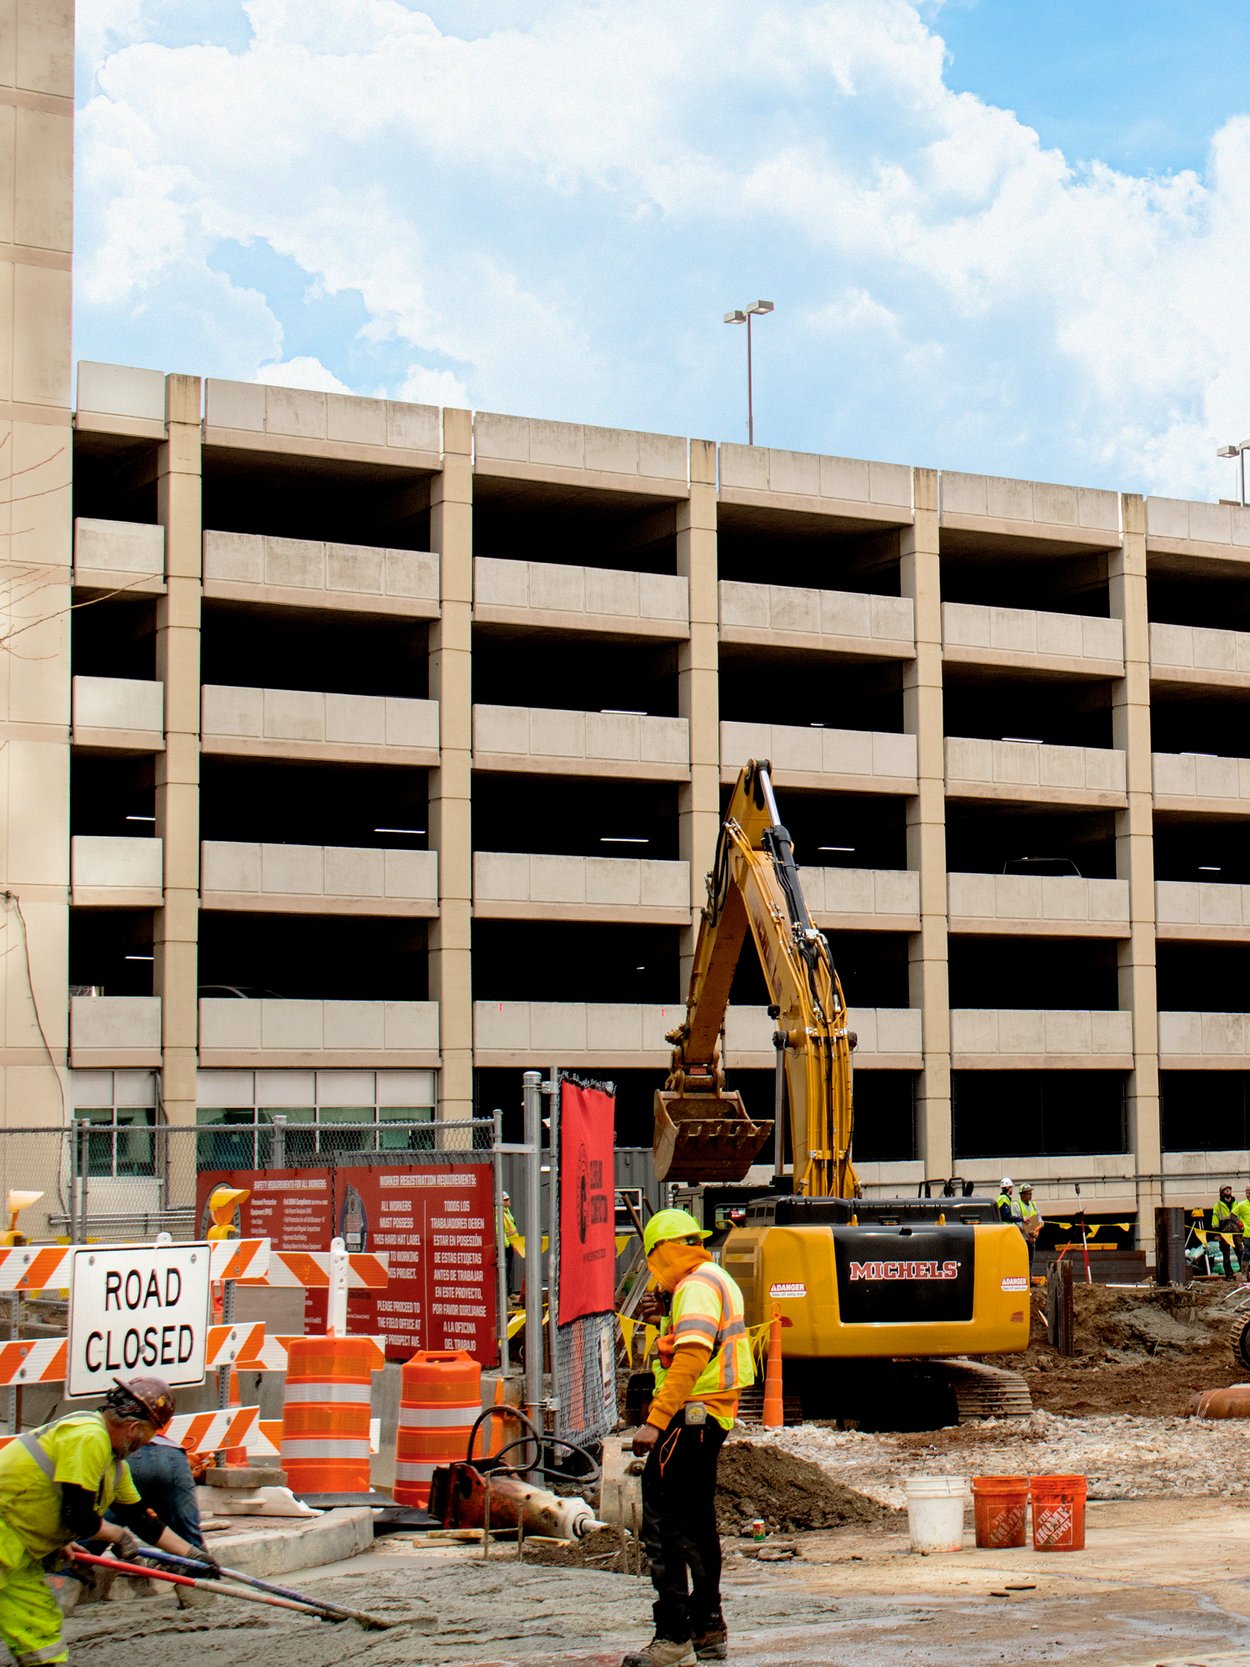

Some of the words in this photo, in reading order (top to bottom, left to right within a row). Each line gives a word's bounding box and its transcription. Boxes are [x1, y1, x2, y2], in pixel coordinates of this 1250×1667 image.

[400, 1175, 436, 1186] REGISTRATION
[381, 1201, 391, 1211] ALL
[391, 1201, 412, 1211] WORKERS
[444, 1201, 460, 1211] TODOS
[460, 1201, 470, 1211] LOS
[380, 1218, 392, 1228] MUST
[393, 1218, 414, 1228] POSSESS
[431, 1218, 468, 1229] TRABAJADORES
[374, 1234, 385, 1245] THIS
[385, 1234, 398, 1245] HARD
[398, 1235, 406, 1245] HAT
[407, 1235, 421, 1245] LABEL
[433, 1235, 449, 1246] ESTAR
[449, 1235, 457, 1246] EN
[397, 1251, 419, 1262] WORKING
[434, 1252, 442, 1263] DE
[442, 1252, 457, 1263] ESTAS
[433, 1269, 449, 1280] ANTES
[449, 1270, 457, 1280] DE
[457, 1270, 483, 1281] TRABAJAR
[850, 1261, 959, 1280] MICHELS
[1006, 1277, 1027, 1285] DANGER
[105, 1267, 182, 1311] ROAD
[435, 1287, 442, 1298] EN
[442, 1287, 455, 1298] ESTE
[455, 1287, 482, 1300] PROYECTO,
[776, 1284, 804, 1292] DANGER
[377, 1300, 393, 1312] PLEASE
[393, 1301, 413, 1313] PROCEED
[413, 1302, 420, 1314] TO
[432, 1304, 444, 1315] POR
[444, 1304, 460, 1316] FAVOR
[377, 1317, 386, 1327] THE
[386, 1318, 398, 1328] FIELD
[399, 1318, 414, 1329] OFFICE
[447, 1322, 454, 1332] LA
[454, 1322, 476, 1334] OFICINA
[389, 1334, 410, 1346] PROSPECT
[444, 1339, 454, 1350] DEL
[454, 1339, 477, 1351] TRABAJO
[86, 1324, 194, 1373] CLOSED
[1038, 1508, 1052, 1524] THE
[1036, 1504, 1073, 1545] HOME
[1048, 1519, 1073, 1545] DEPOT
